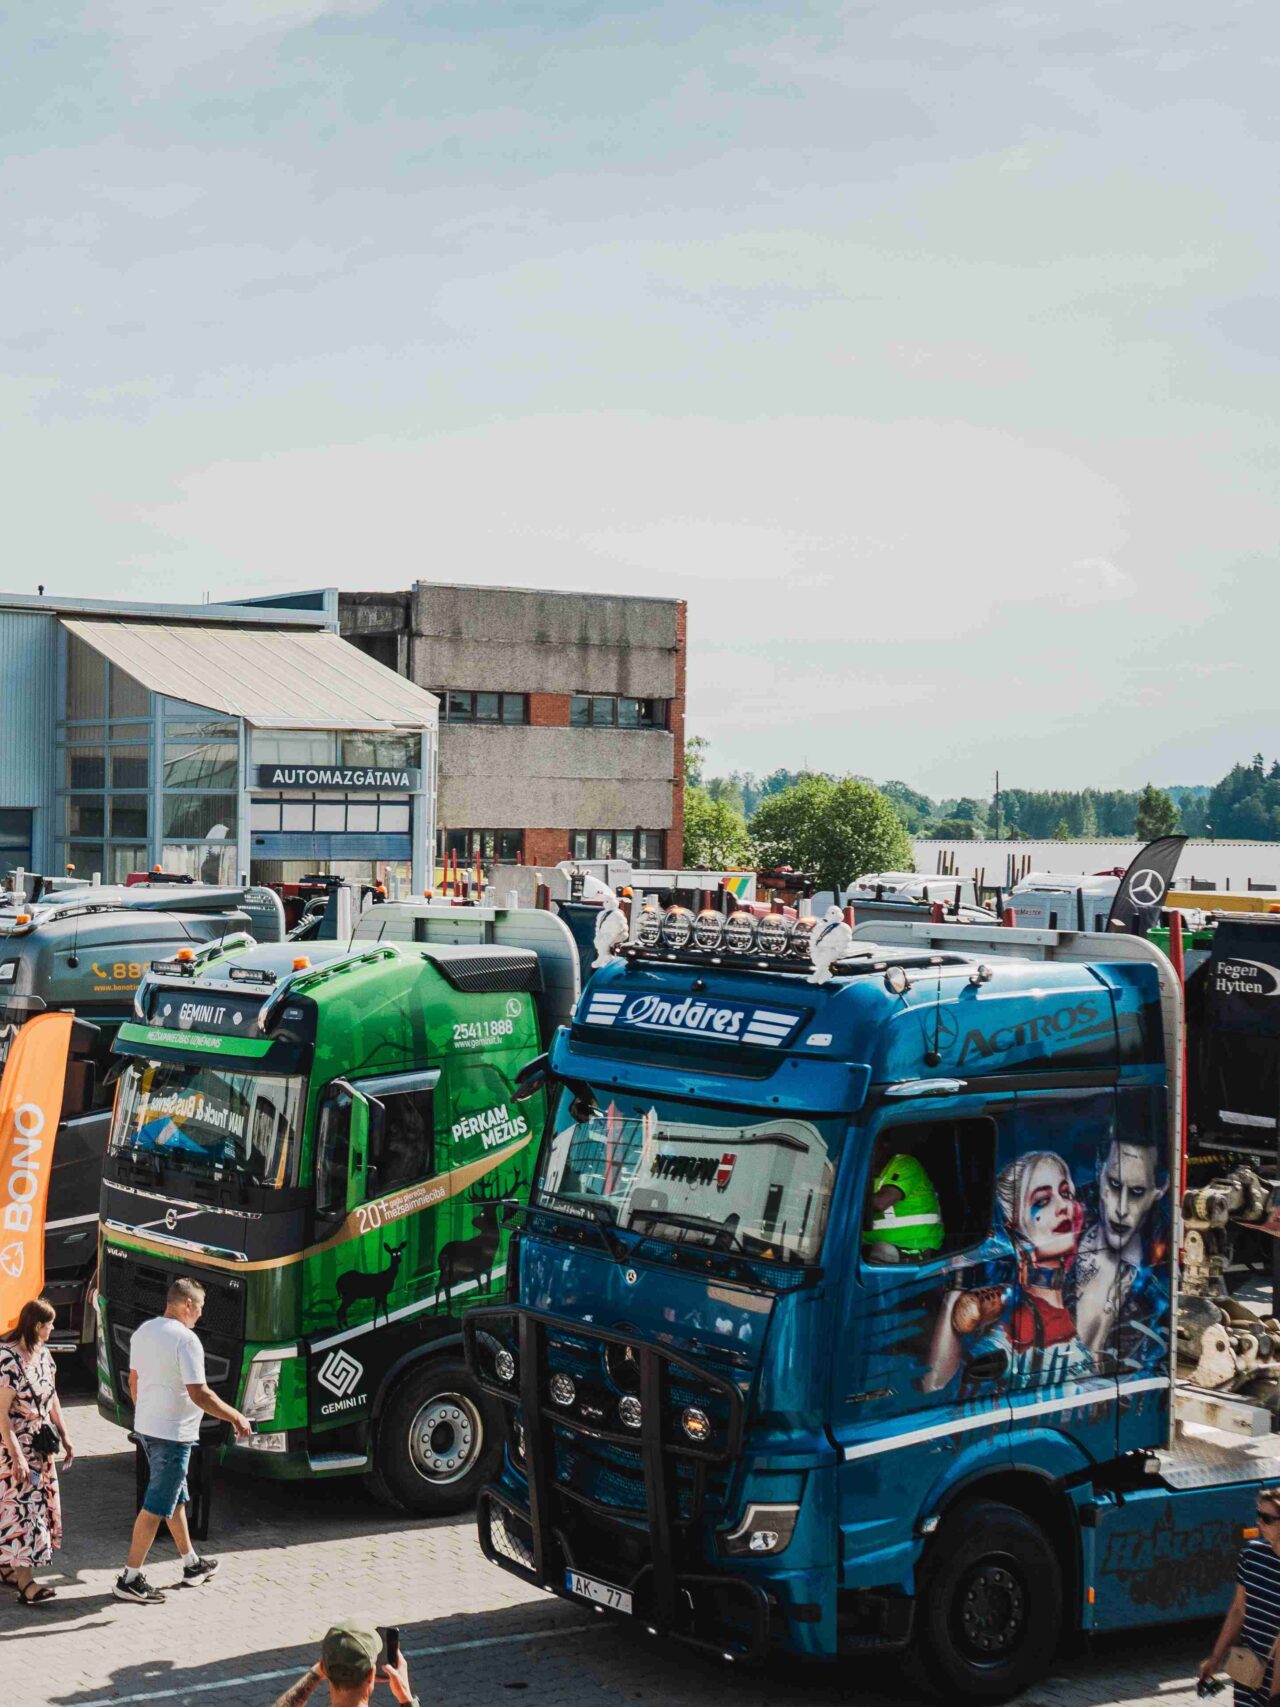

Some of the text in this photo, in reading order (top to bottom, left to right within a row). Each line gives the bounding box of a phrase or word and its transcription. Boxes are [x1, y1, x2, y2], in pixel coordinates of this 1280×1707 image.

[272, 767, 410, 787] AUTOMAZGĀTAVA
[1217, 962, 1258, 978] Fegen
[1216, 978, 1263, 994] Hytten
[180, 1003, 226, 1025] GEMINI IT
[453, 1020, 513, 1040] 25411888
[451, 1104, 509, 1142] PĒRKAM
[4, 1103, 45, 1232] BONO
[321, 1393, 367, 1416] GEMINI IT
